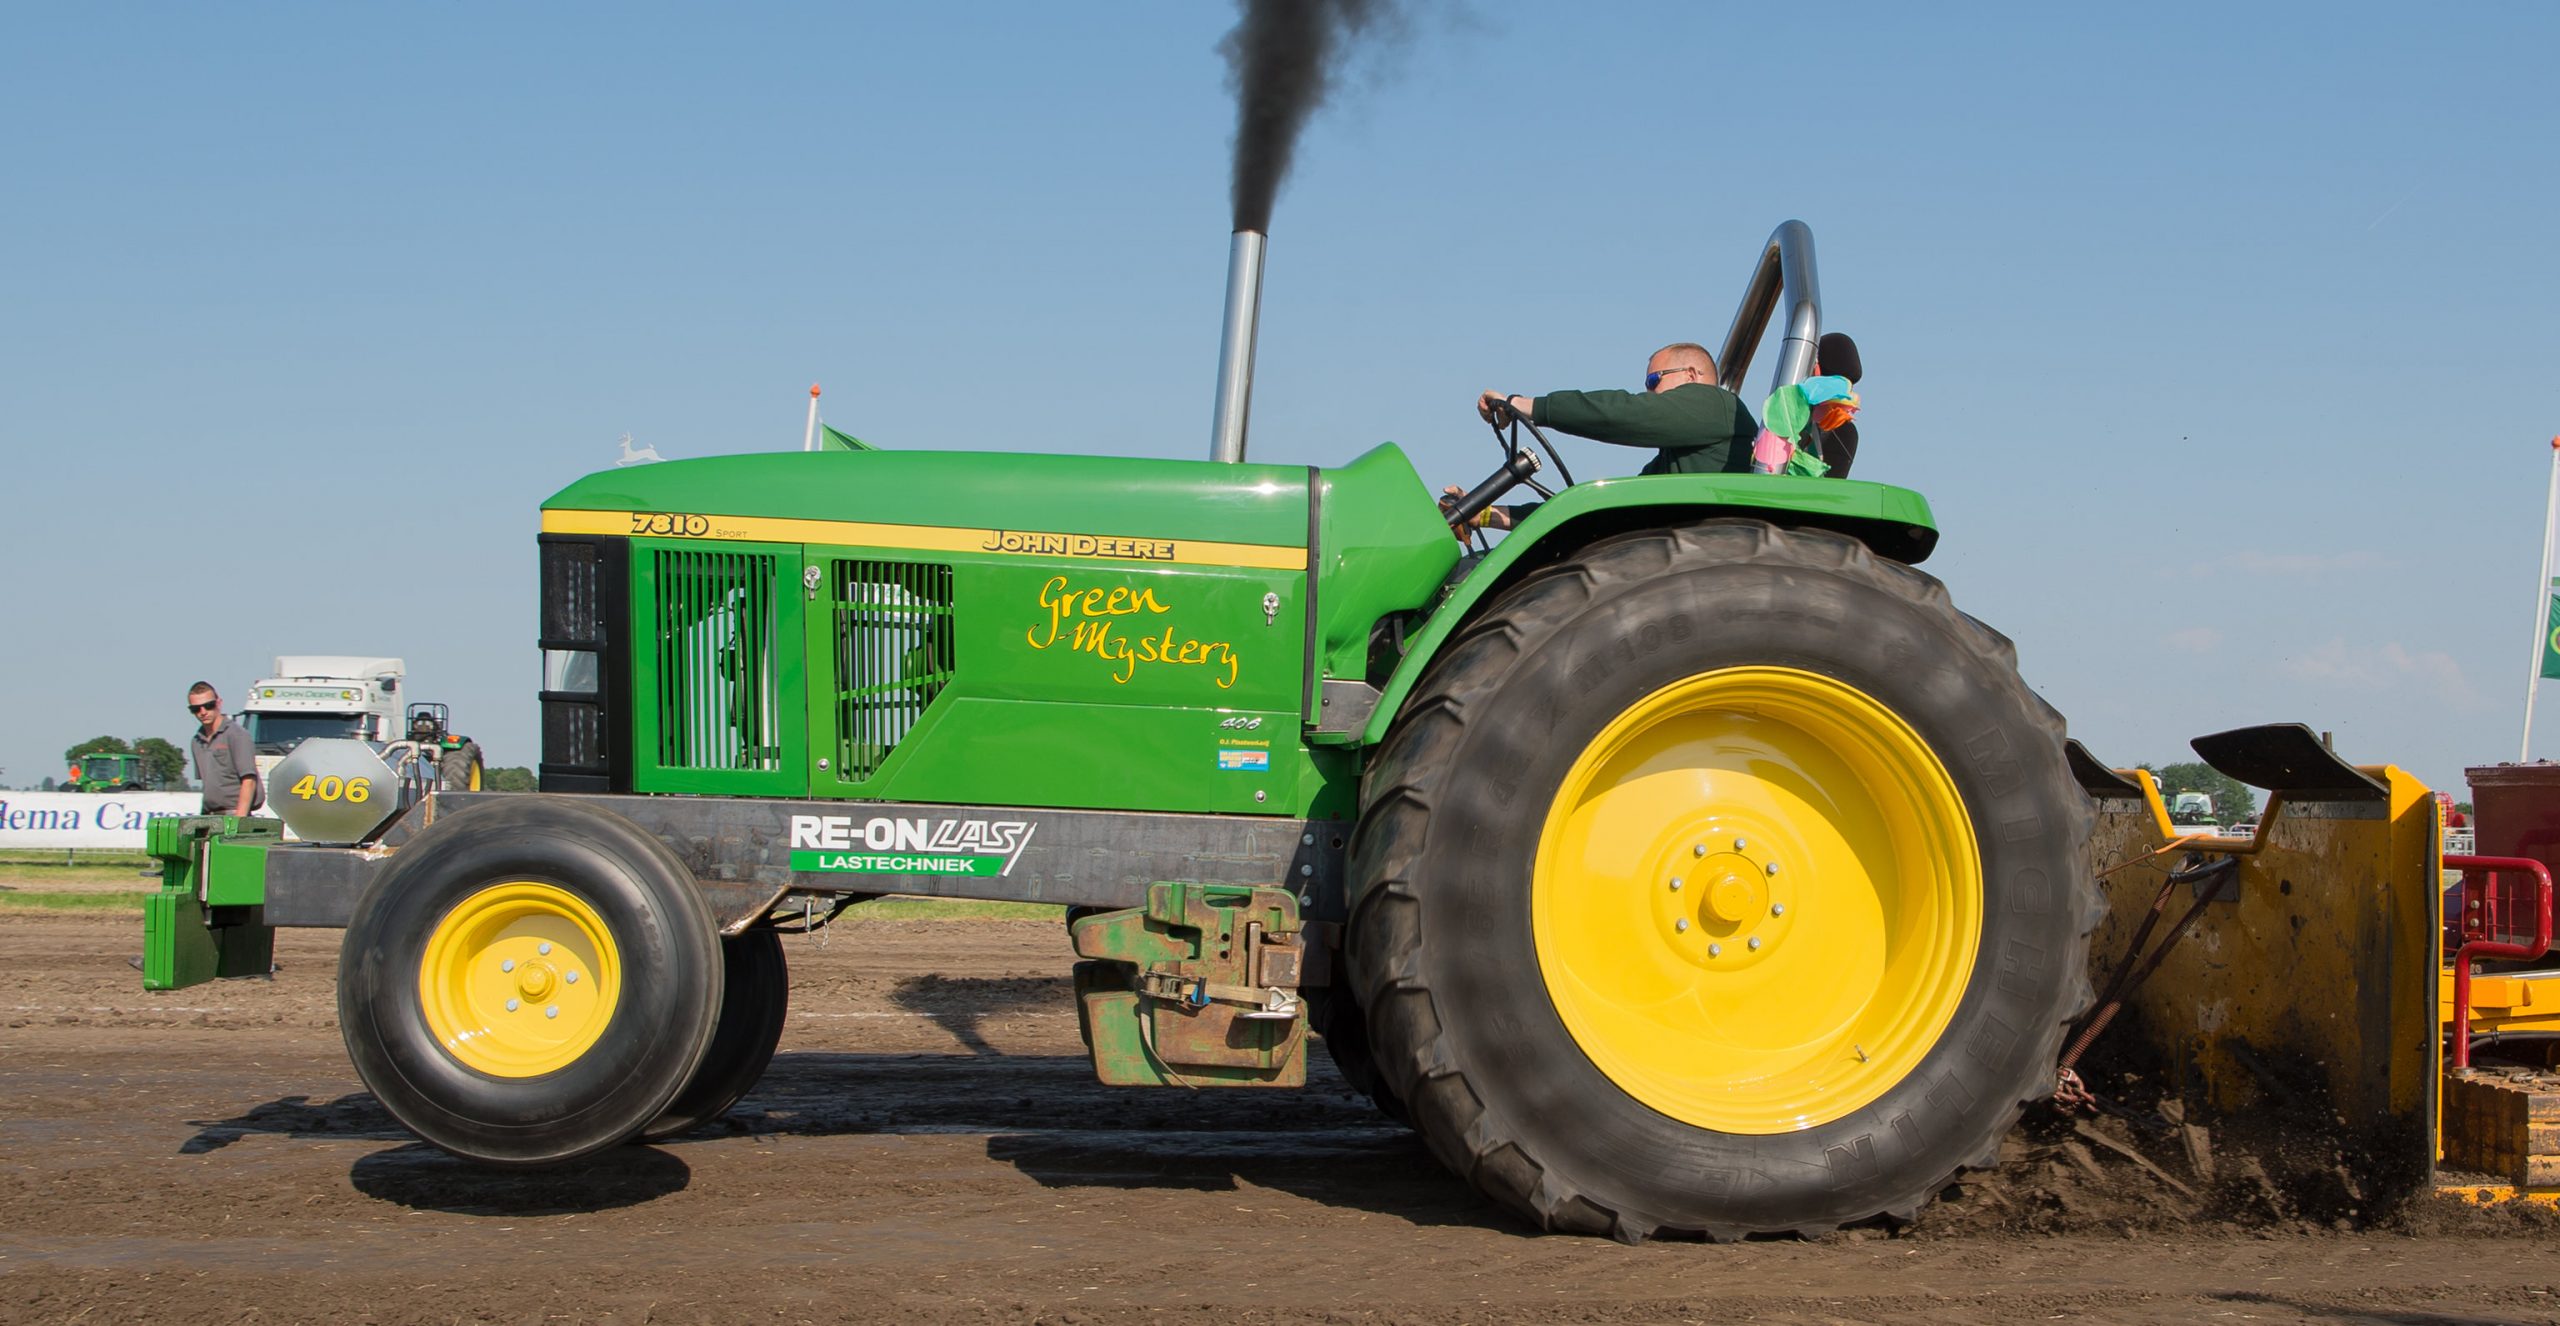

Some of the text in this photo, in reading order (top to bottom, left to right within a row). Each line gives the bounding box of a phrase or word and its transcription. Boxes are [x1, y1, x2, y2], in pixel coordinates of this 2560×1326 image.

[631, 512, 748, 538] 7810 SPORT
[982, 530, 1175, 561] JOHN DEERE
[1026, 576, 1171, 650] Green
[1058, 620, 1239, 690] Mystery
[1220, 717, 1263, 730] 406
[290, 774, 372, 803] 406
[819, 855, 976, 873] LASTECHNIEK
[1822, 726, 2052, 1192] MICHELIN
